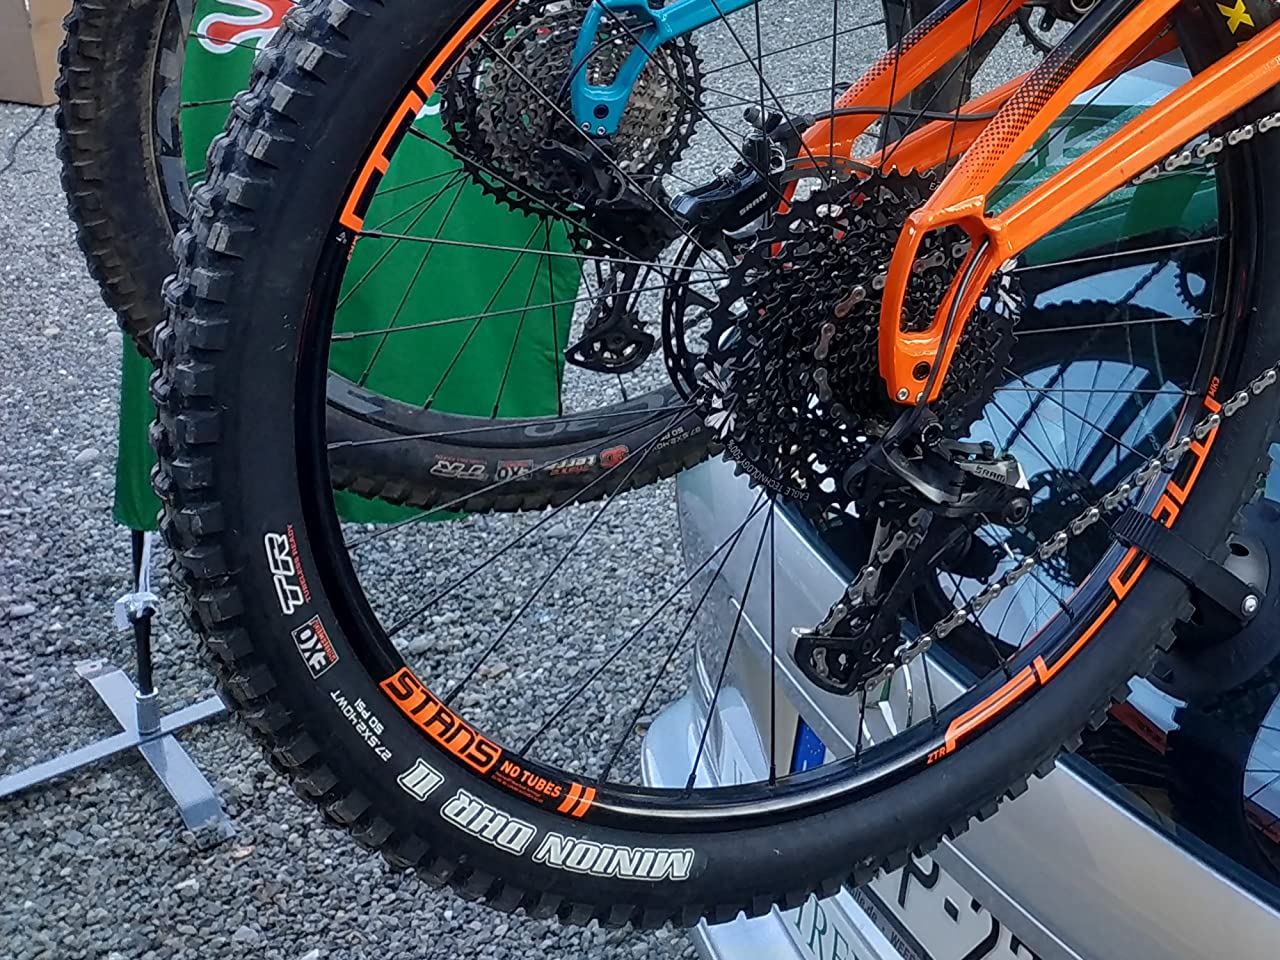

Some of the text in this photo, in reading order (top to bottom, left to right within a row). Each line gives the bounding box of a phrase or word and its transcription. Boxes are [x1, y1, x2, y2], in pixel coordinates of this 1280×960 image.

[739, 191, 768, 217] SRAM
[740, 457, 784, 493] TECHNOLOGY
[975, 464, 1006, 482] SRAM
[784, 486, 811, 501] EAGLE
[265, 533, 305, 615] TR
[300, 628, 328, 671] EXO
[354, 697, 385, 736] 50 PSI
[926, 746, 946, 765] ZTR
[500, 759, 521, 778] NO
[521, 770, 563, 798] TUBES
[440, 788, 537, 856] DHR
[532, 832, 695, 881] MINION
